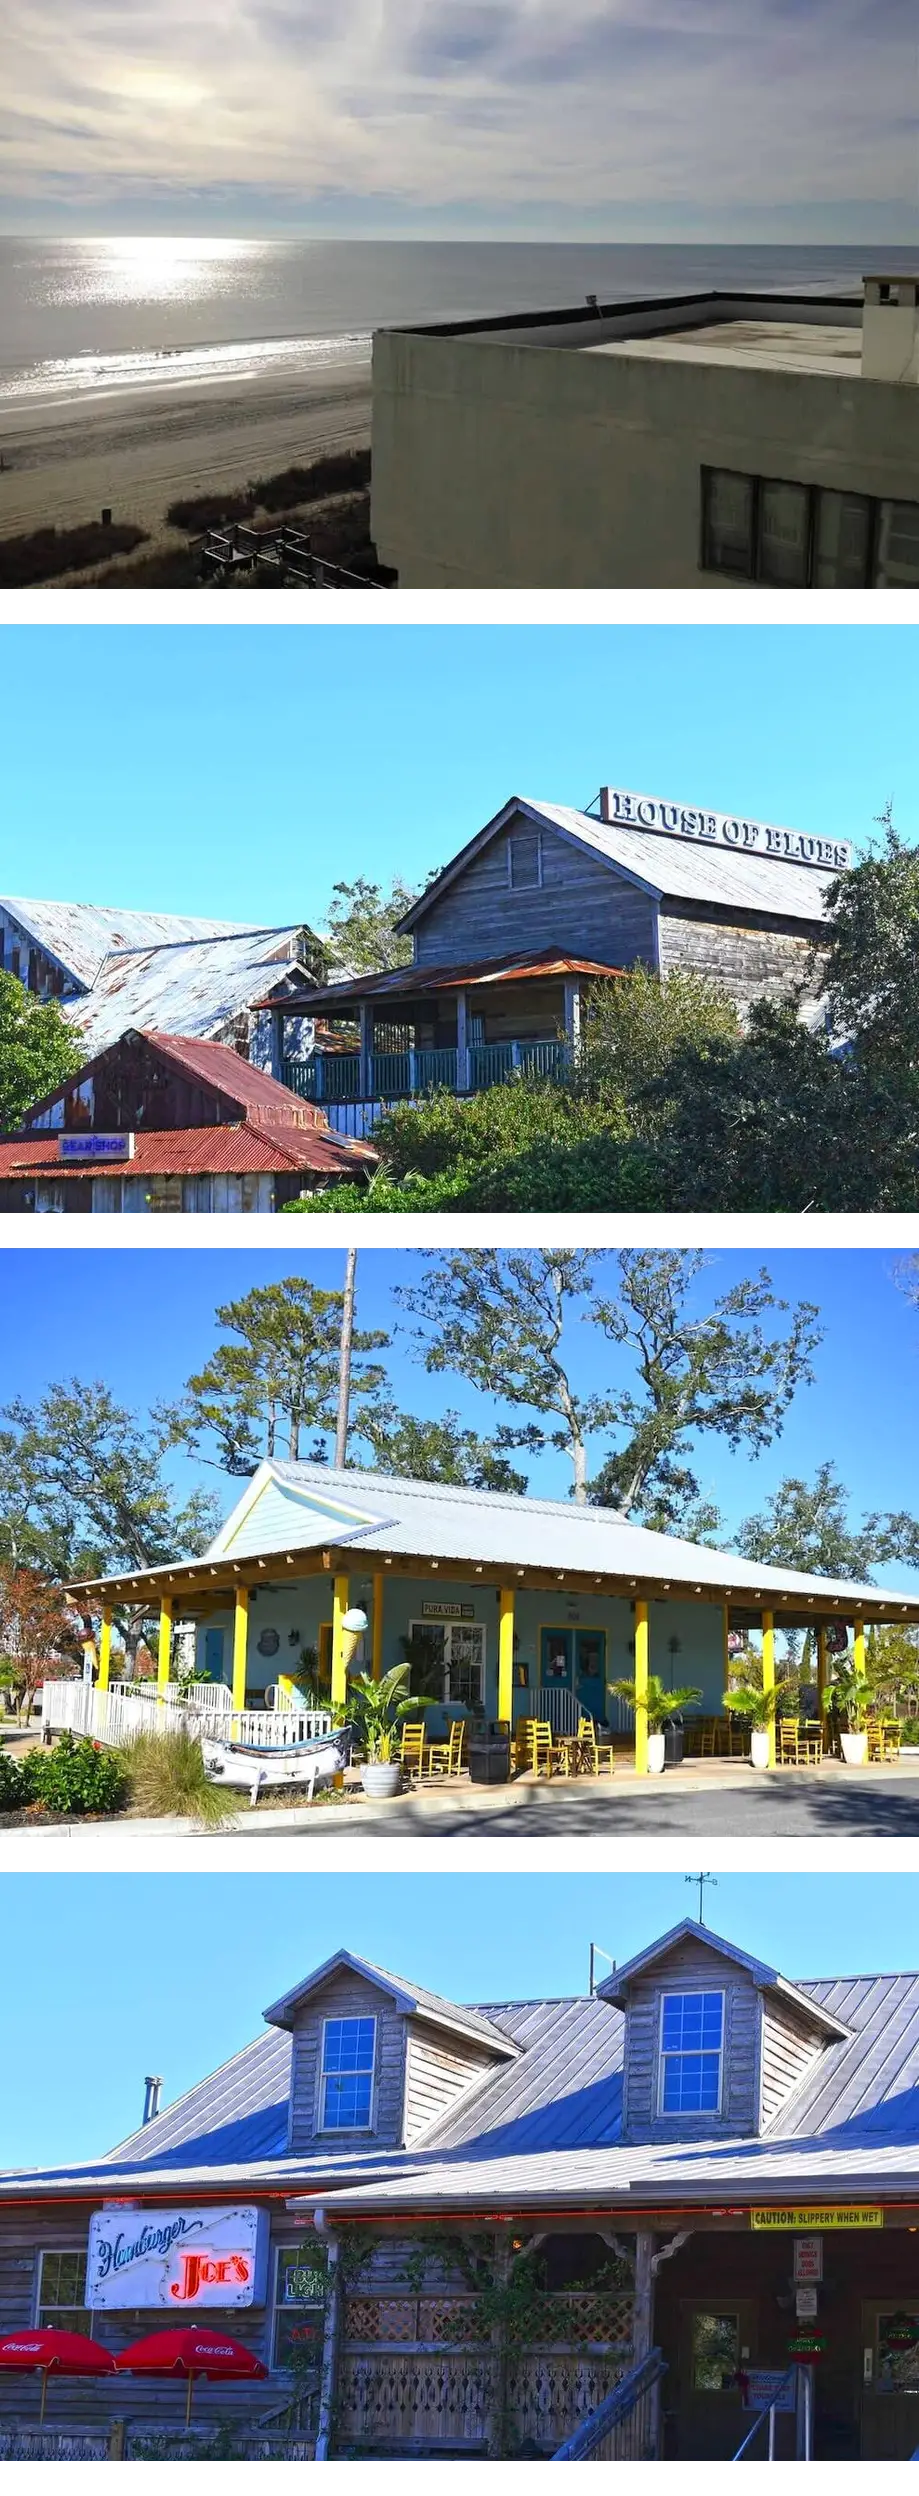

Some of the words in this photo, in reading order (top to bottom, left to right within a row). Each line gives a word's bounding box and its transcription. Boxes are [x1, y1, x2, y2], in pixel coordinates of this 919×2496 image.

[613, 793, 717, 839] HOUSE
[722, 819, 759, 847] OF
[765, 827, 850, 867] BLUES
[97, 2217, 203, 2278] Hamburger
[755, 2211, 796, 2224] CAUTION:
[798, 2212, 835, 2223] SLIPPERY
[836, 2212, 860, 2222] WHEN
[862, 2211, 879, 2222] WET
